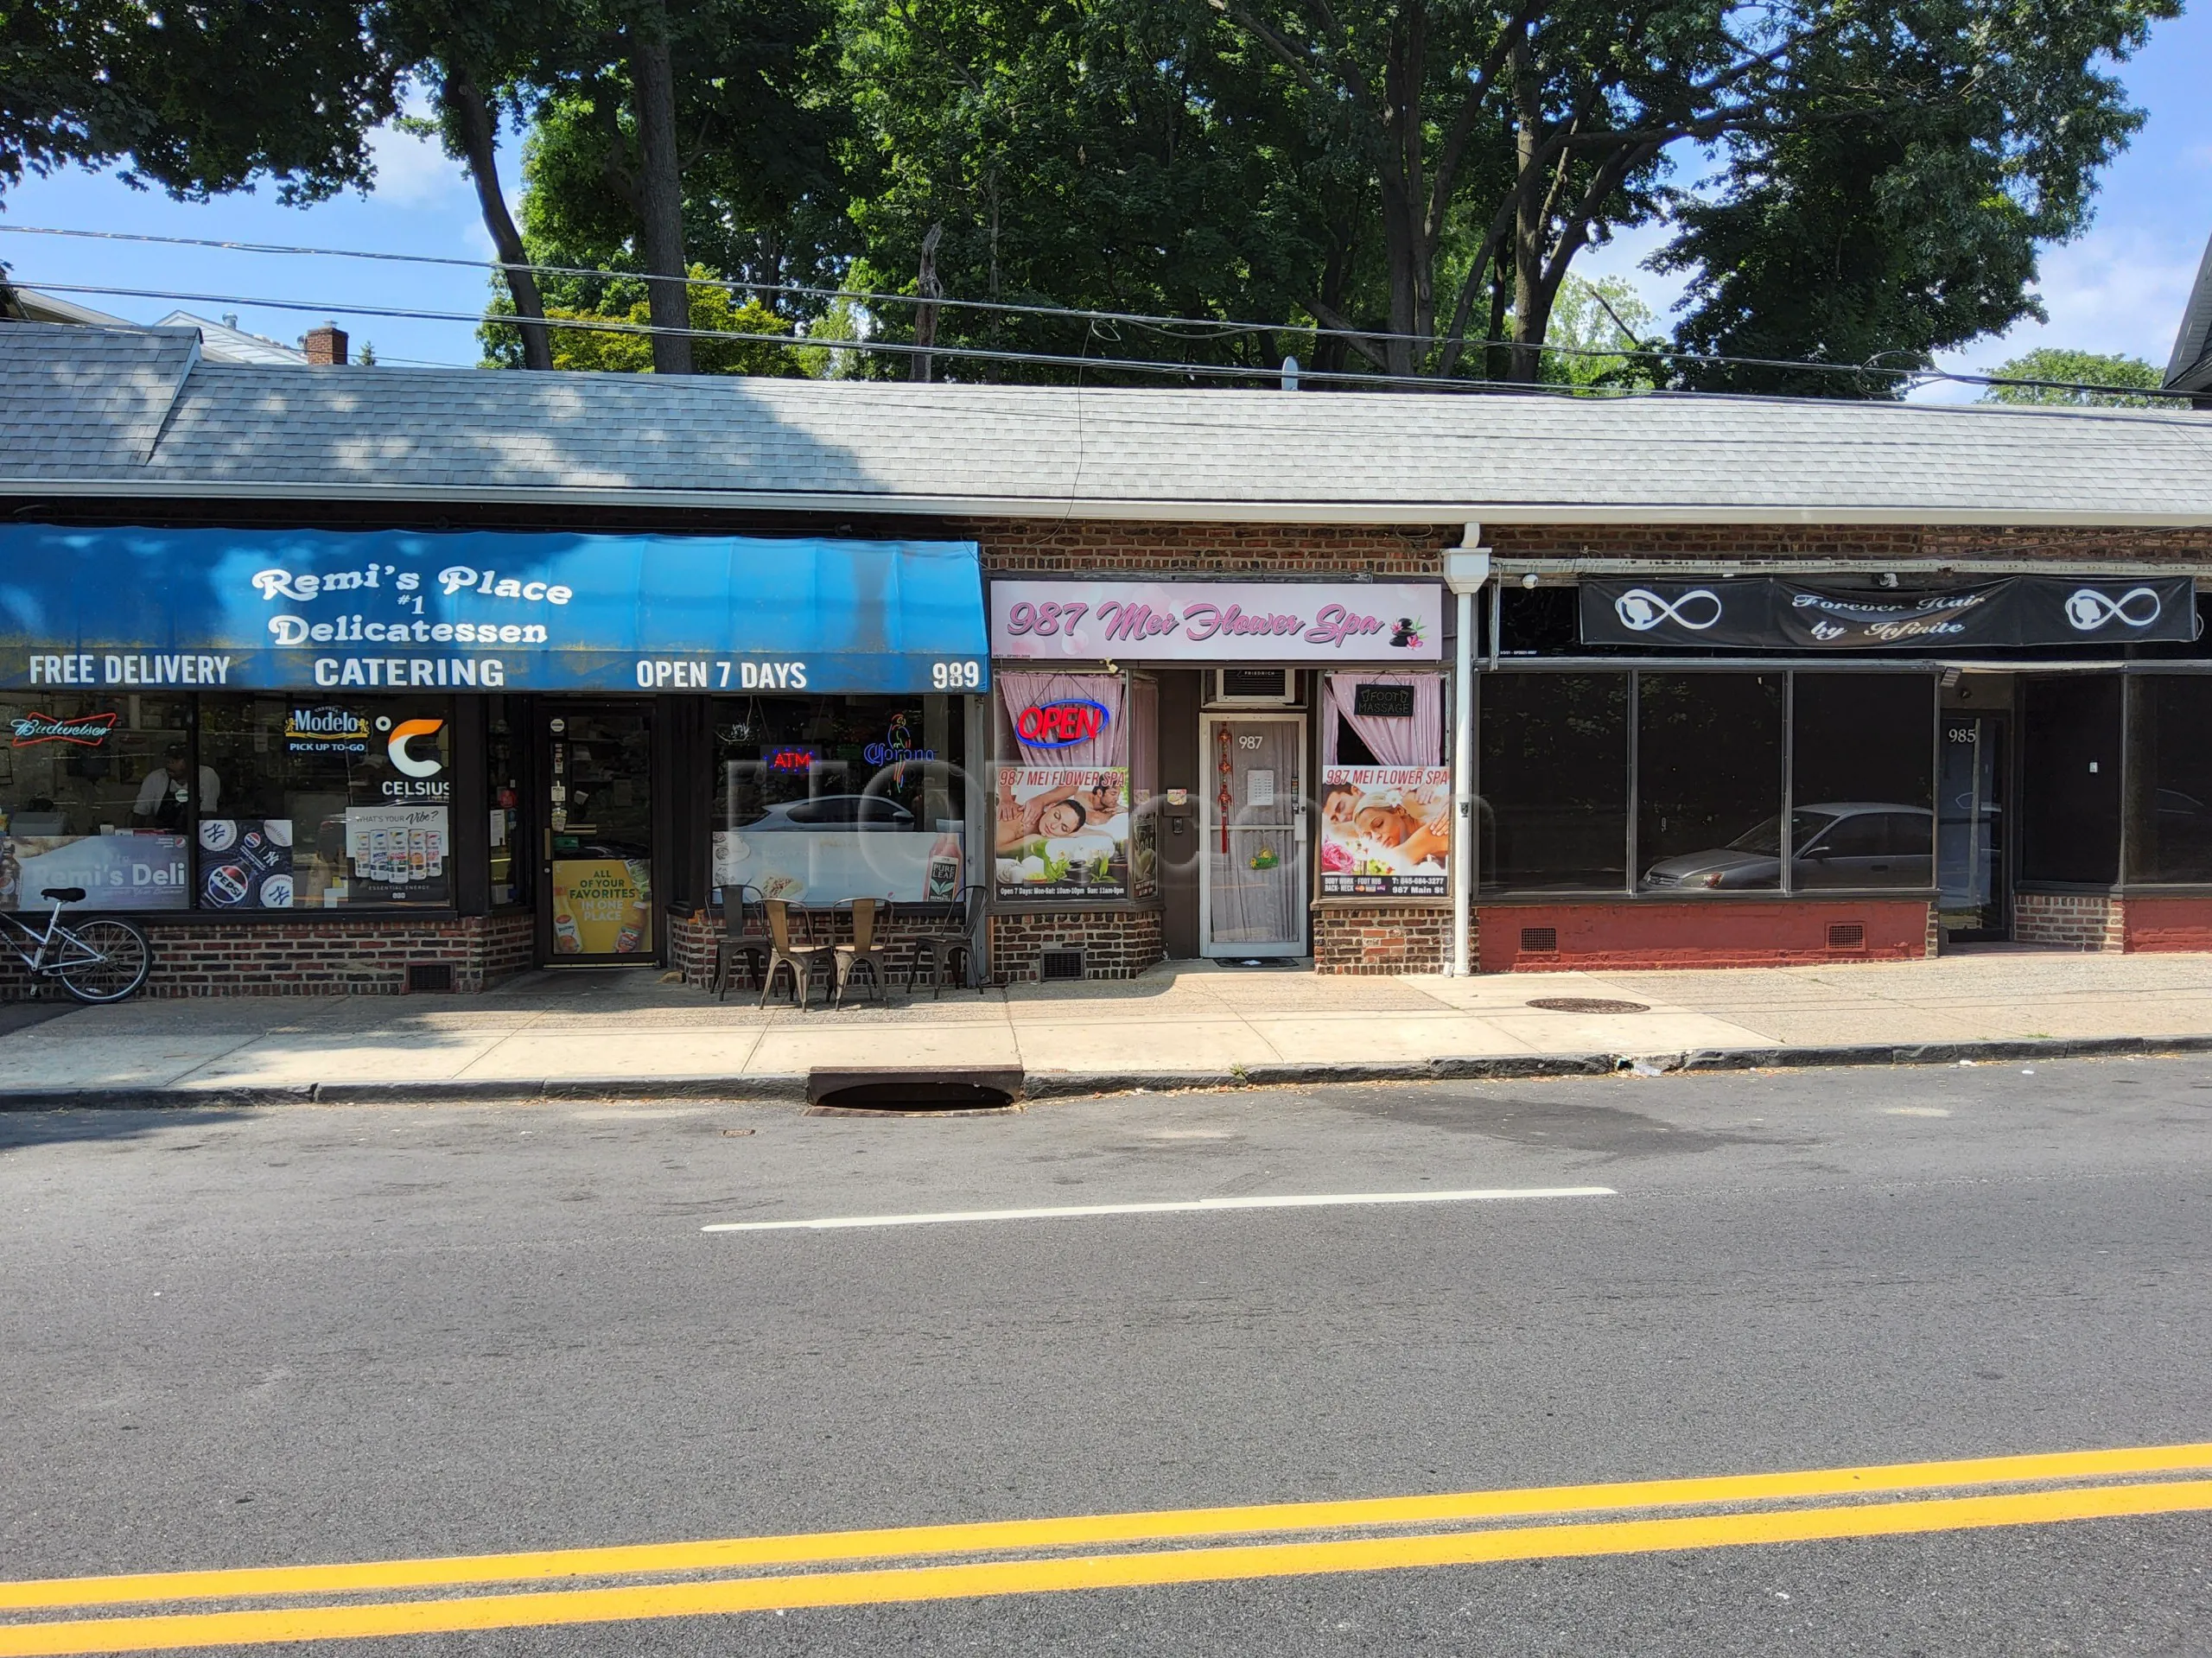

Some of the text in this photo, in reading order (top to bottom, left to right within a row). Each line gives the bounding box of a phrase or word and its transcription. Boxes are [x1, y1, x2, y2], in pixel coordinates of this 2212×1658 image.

[251, 562, 573, 606] Remi's Place
[397, 594, 424, 614] #1
[1791, 594, 1986, 613] Forever Hair
[268, 614, 548, 645] Delicatessen
[1007, 600, 1386, 648] 987 Mei Flower Spa
[1810, 620, 1966, 641] by Infinite
[29, 655, 231, 684] FREE DELIVERY
[315, 657, 505, 687] CATERING
[636, 659, 807, 689] OPEN 7 DAYS
[931, 660, 979, 689] 989
[1370, 689, 1399, 702] FOOT
[1358, 702, 1409, 714] MASSAGE
[10, 719, 111, 736] Budweiser
[295, 708, 359, 733] Modelo
[1018, 705, 1102, 740] OPEN
[1238, 735, 1263, 749] 987
[1948, 728, 1976, 743] 985
[289, 743, 365, 752] PICK UP TO-GO
[864, 742, 936, 766] Corona
[774, 752, 812, 769] ATM
[999, 771, 1126, 787] 987 MEI FLOWER SPA
[1325, 769, 1449, 785] 987 MEI FLOWER SPA
[405, 810, 439, 824] Vibe?
[131, 862, 185, 886] Deli
[213, 870, 242, 899] PEPSI
[1001, 887, 1014, 896] Open
[1019, 887, 1033, 896] Days:
[1057, 887, 1084, 896] 10am-10pm
[1392, 886, 1408, 894] 987
[1410, 886, 1432, 894] Main
[569, 889, 636, 899] FAVORITES
[582, 900, 624, 910] IN ONE
[584, 912, 622, 921] PLACE
